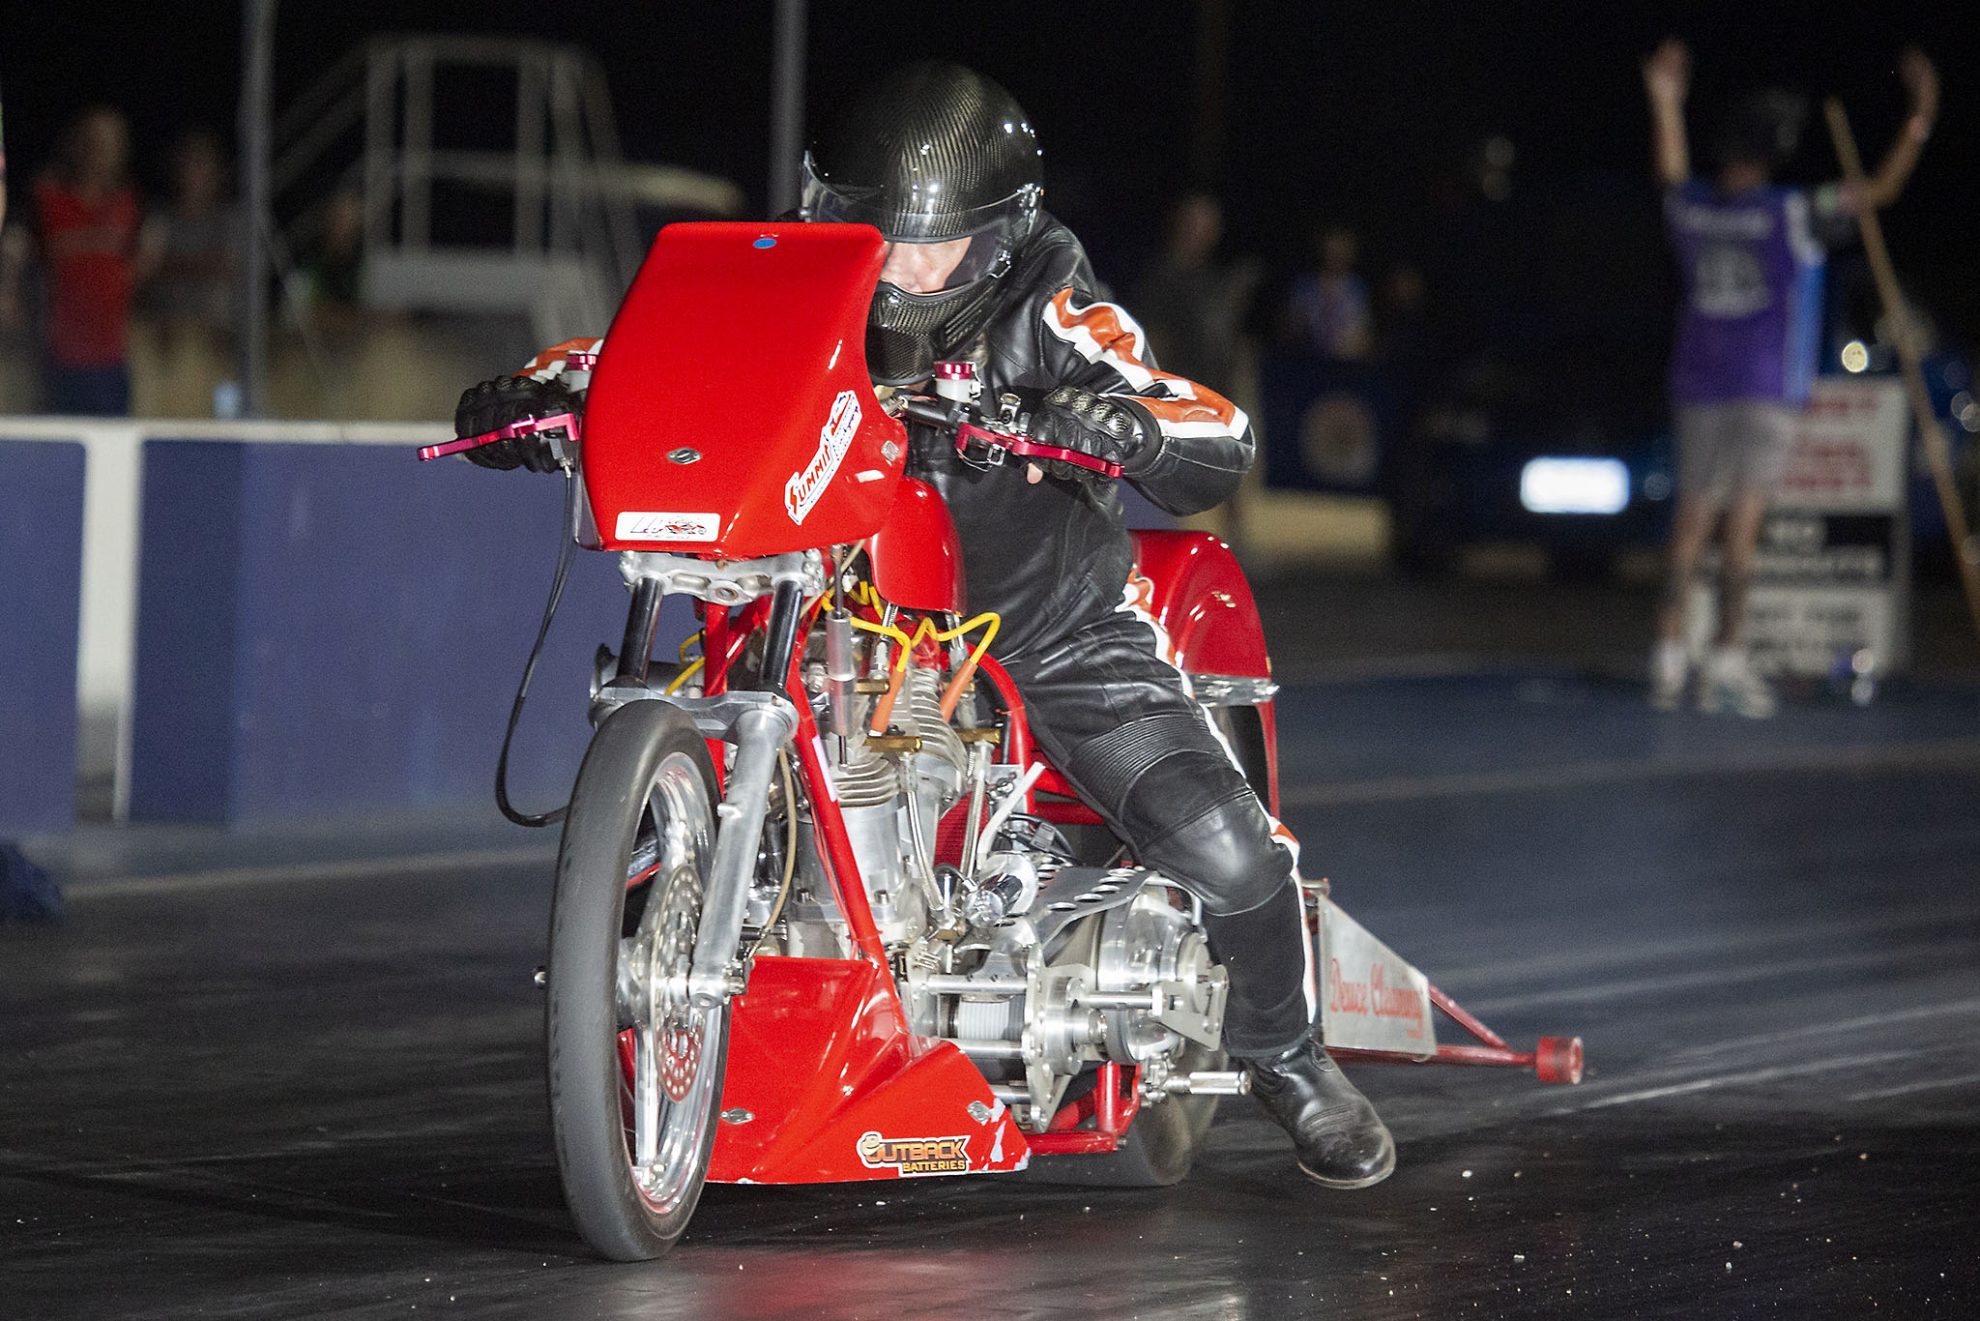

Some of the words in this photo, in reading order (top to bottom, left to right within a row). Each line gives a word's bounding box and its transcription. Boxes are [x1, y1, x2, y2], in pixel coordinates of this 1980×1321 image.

[788, 443, 831, 516] SUMMIT
[860, 1134, 966, 1163] OUTBACK
[902, 1160, 966, 1172] BATTERIES
